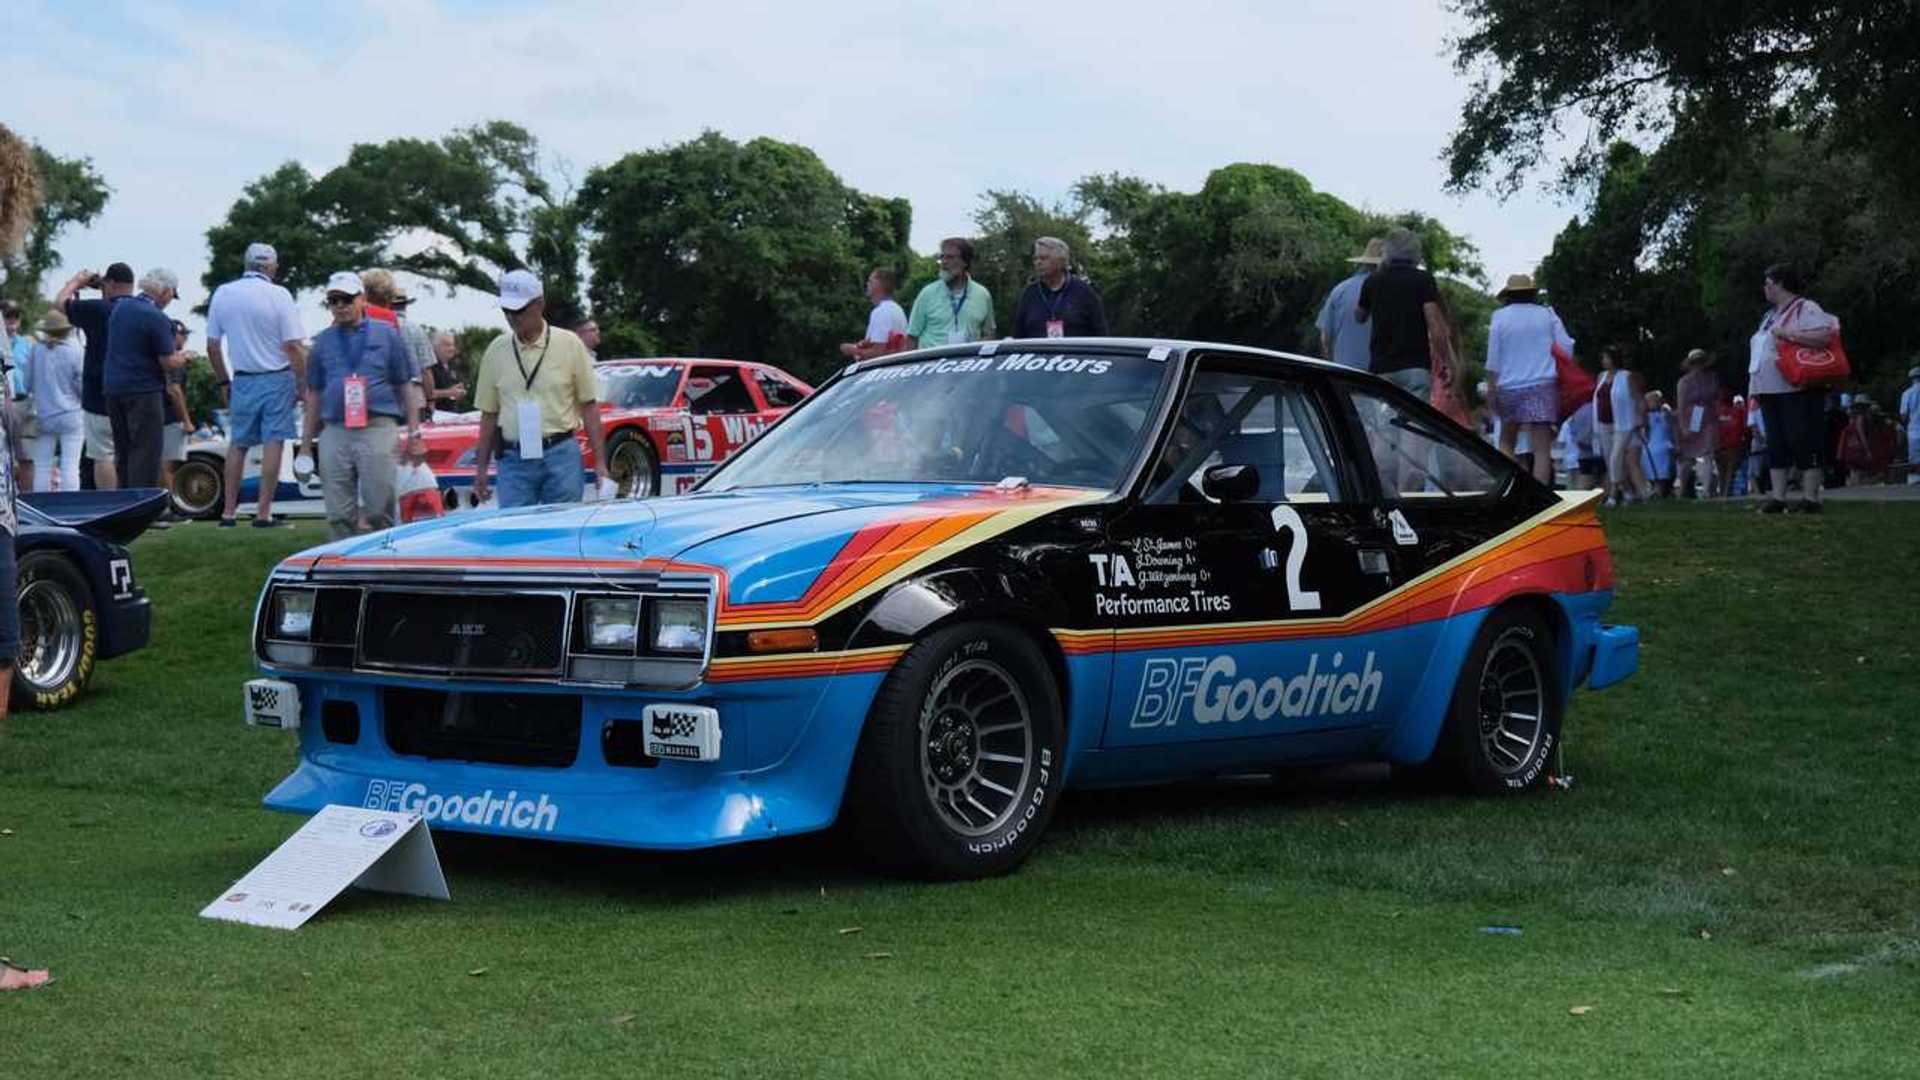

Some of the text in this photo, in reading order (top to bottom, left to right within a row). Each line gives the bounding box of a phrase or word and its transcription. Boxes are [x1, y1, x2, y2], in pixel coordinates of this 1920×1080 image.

[856, 353, 1114, 385] American Motors
[681, 414, 714, 461] 15
[1089, 552, 1136, 588] T/A
[1270, 504, 1322, 611] 2
[1096, 590, 1232, 616] Performance Tires
[1130, 650, 1384, 729] BFGoodrich
[364, 779, 559, 833] BFGoodrich
[968, 746, 1052, 855] BFGoodrich
